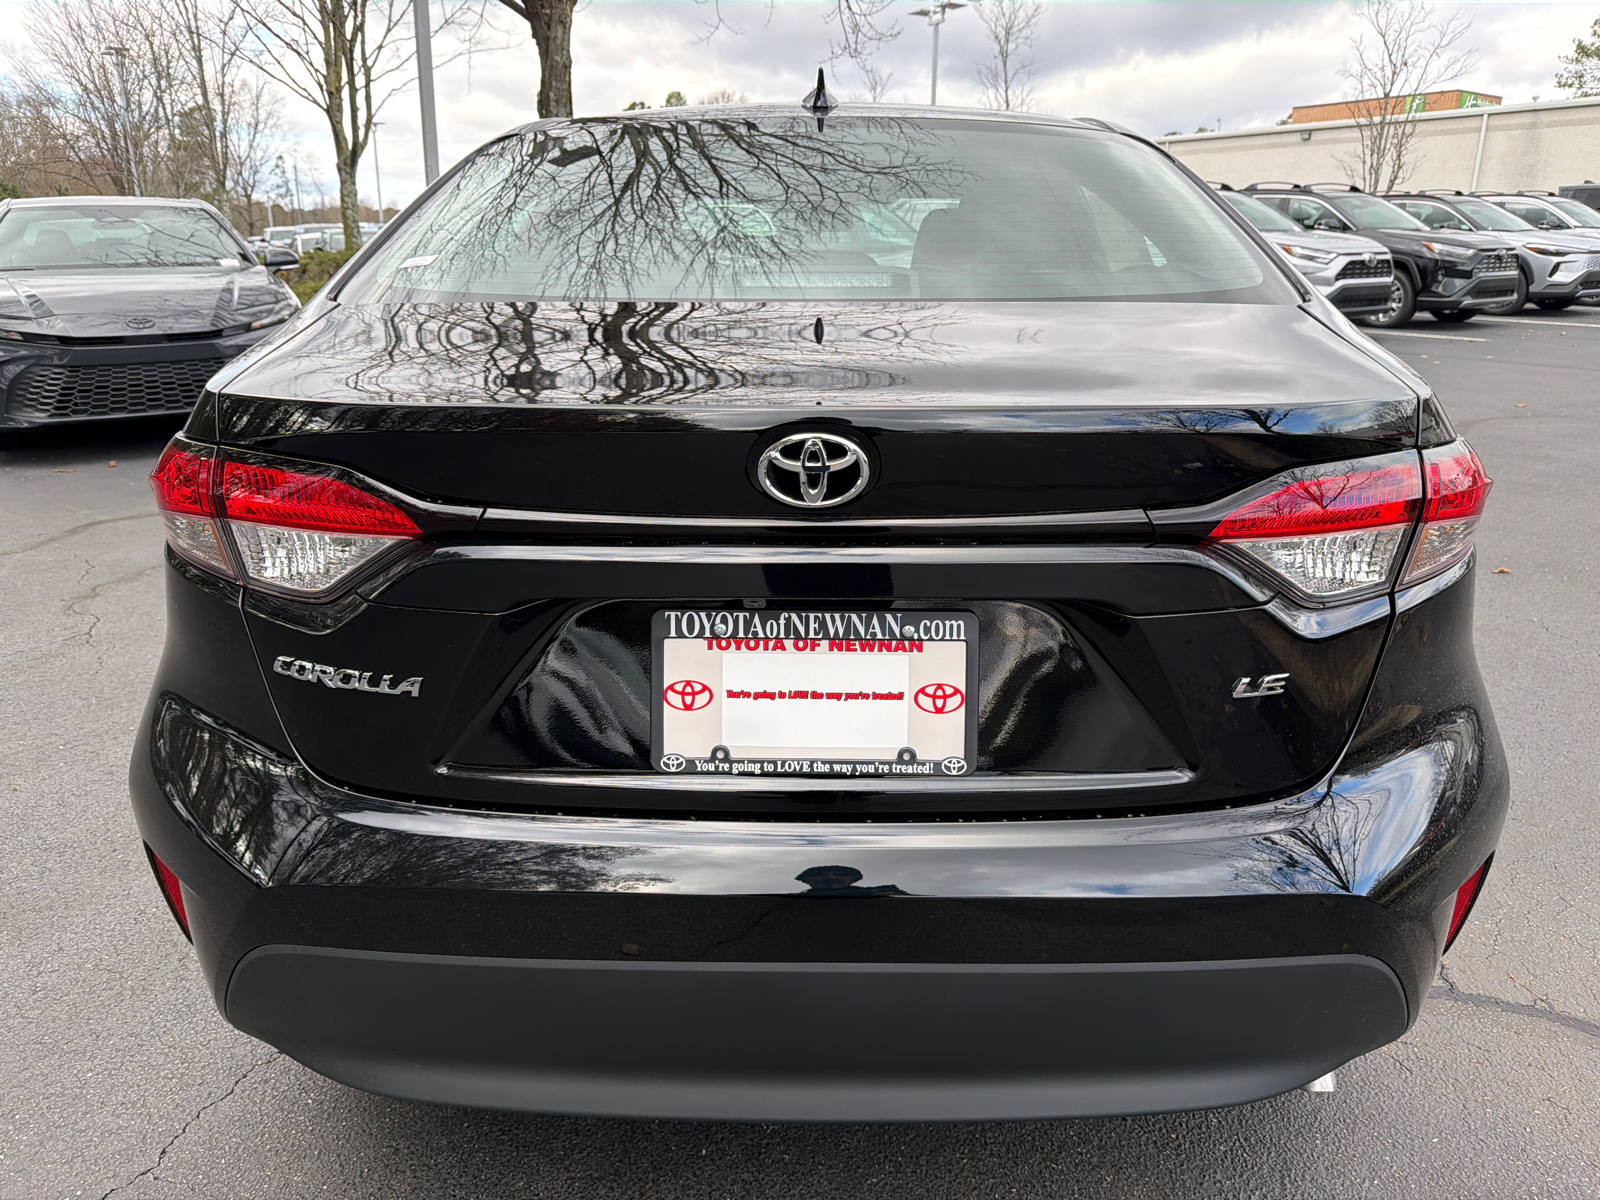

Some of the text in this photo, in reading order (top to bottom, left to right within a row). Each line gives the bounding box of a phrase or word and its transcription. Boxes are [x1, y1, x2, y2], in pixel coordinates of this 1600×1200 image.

[703, 638, 924, 653] TOYOTA OF NEWNAN
[273, 655, 424, 697] COROLLA
[1231, 673, 1290, 699] LE
[726, 689, 905, 702] You're going to LOVE the way you're treated!
[695, 760, 934, 776] You're going to LOVE the way you're treated!
